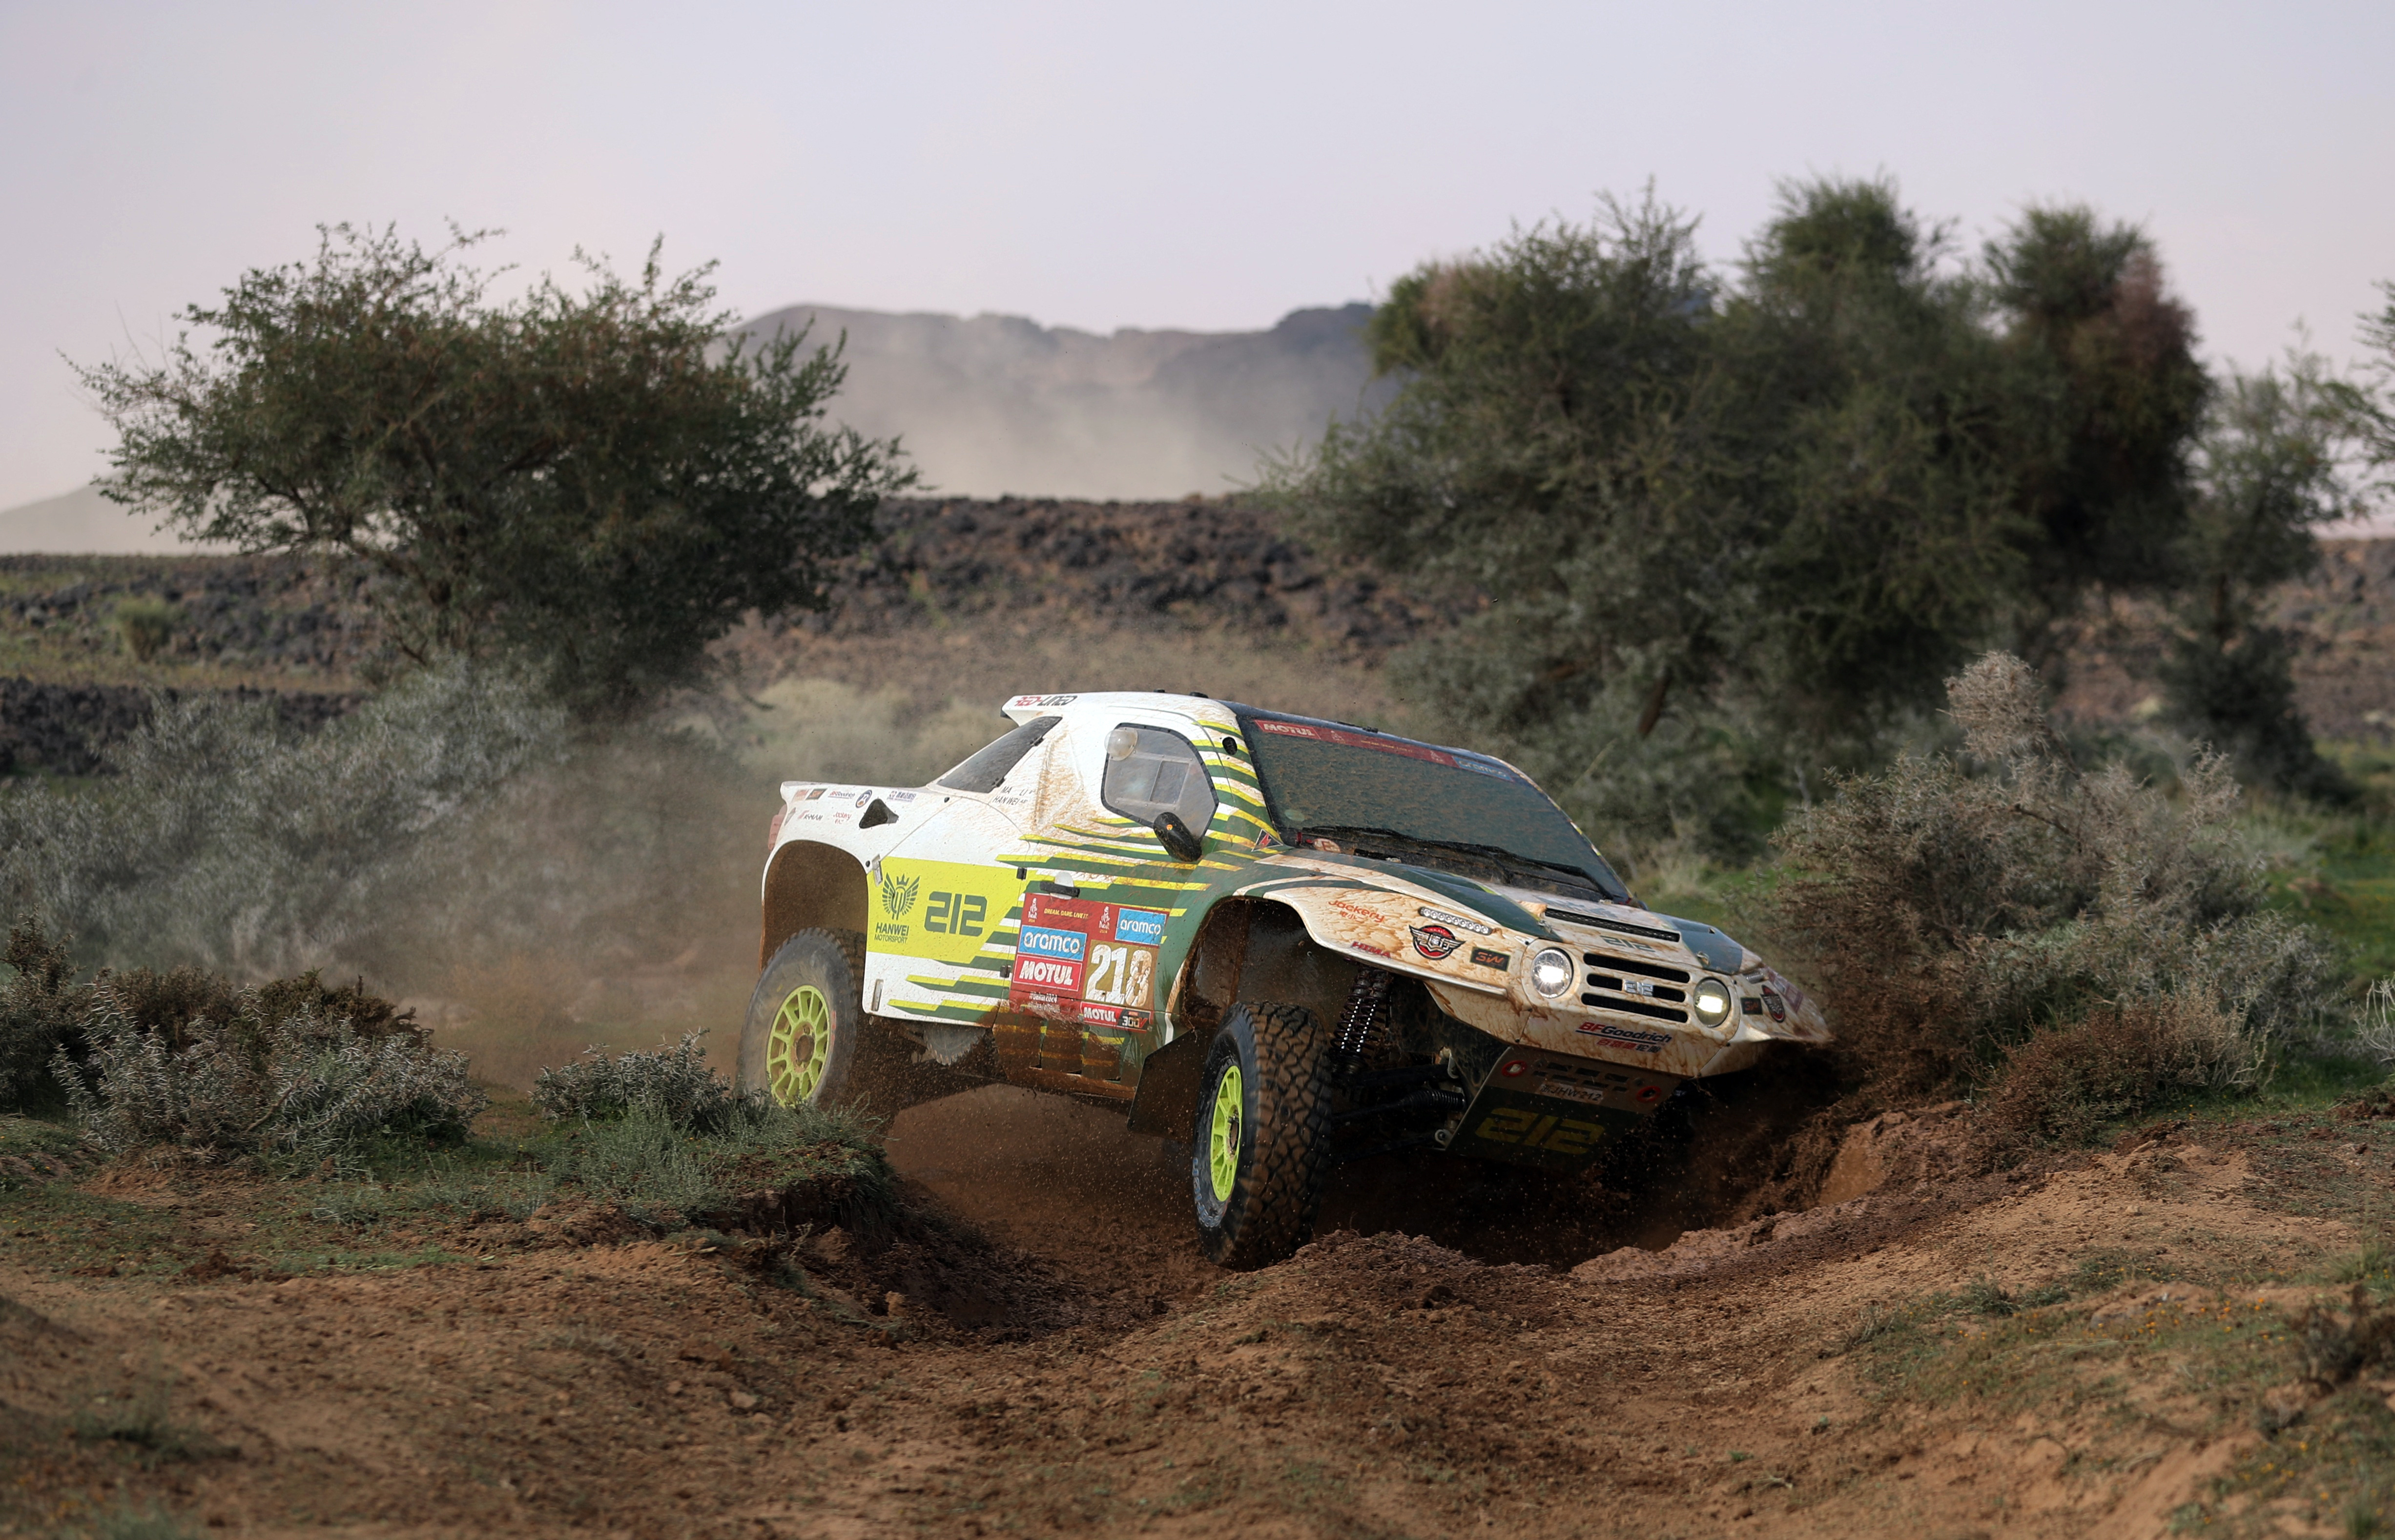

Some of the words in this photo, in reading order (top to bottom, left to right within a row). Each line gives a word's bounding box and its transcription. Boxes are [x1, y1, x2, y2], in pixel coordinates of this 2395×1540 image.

[1263, 723, 1315, 736] MOTUL
[1000, 786, 1013, 794] MA
[924, 891, 988, 937] 212
[1328, 900, 1385, 923] Jackery
[875, 922, 909, 936] HANWEI
[1120, 919, 1161, 936] aramco
[874, 933, 908, 944] MOTORSPORT
[1024, 931, 1080, 954] aramco
[1600, 935, 1656, 953] 212
[1019, 960, 1074, 985] MOTUL
[1085, 944, 1153, 1007] 218
[1624, 980, 1653, 997] 212
[1084, 1007, 1116, 1023] MOTUL
[1122, 1015, 1148, 1028] 300V
[1578, 1021, 1672, 1043] BFGoodrich
[1474, 1107, 1605, 1154] 212
